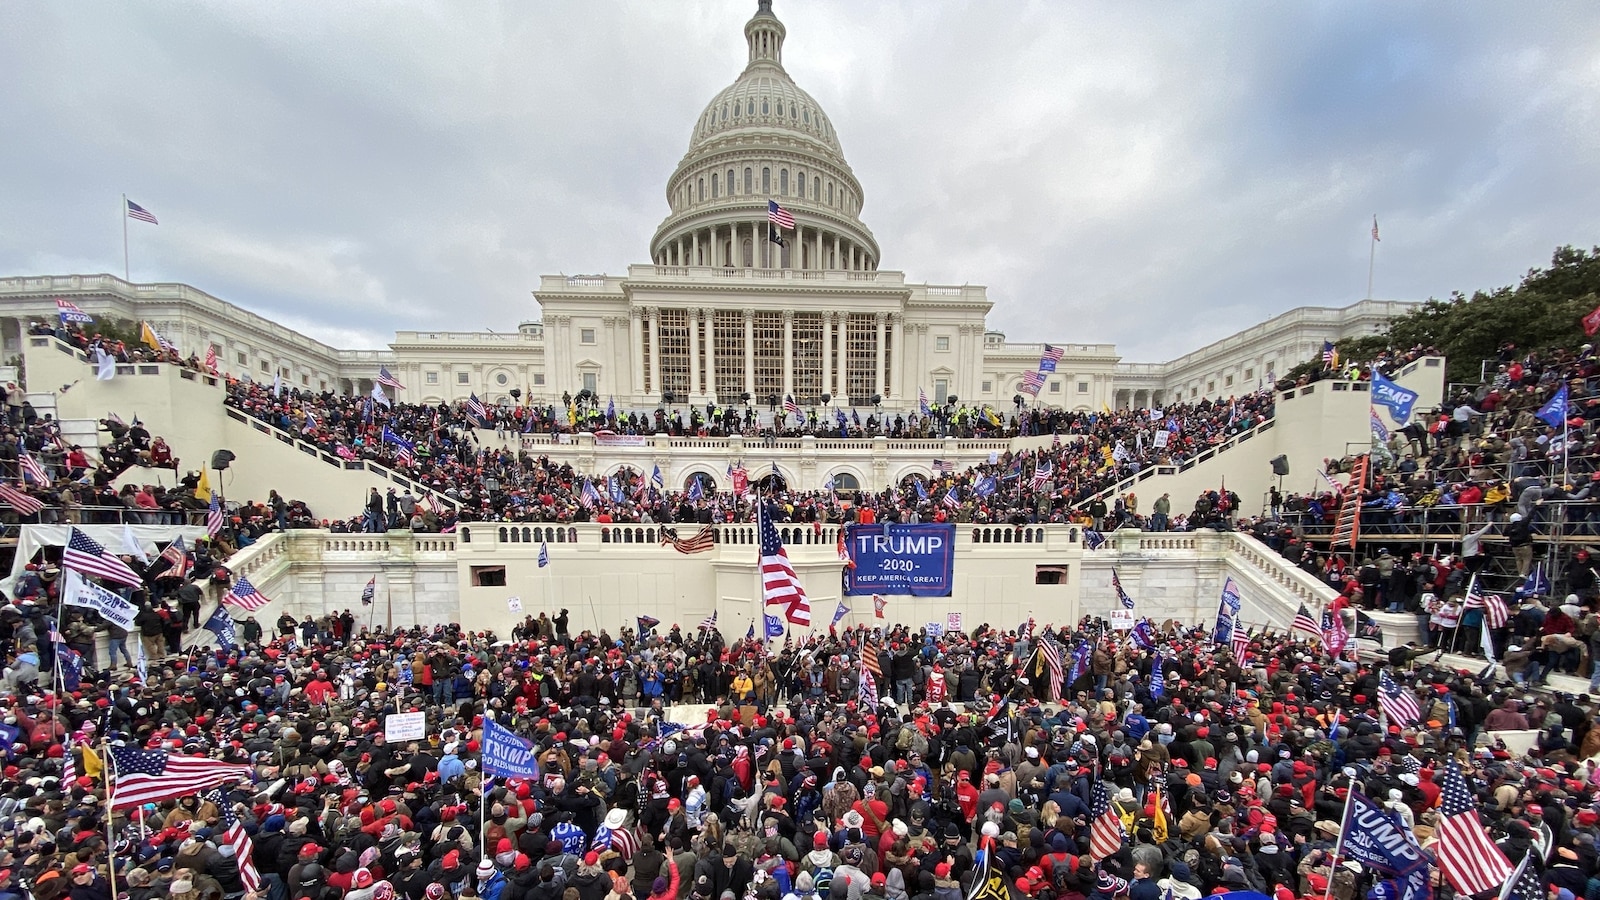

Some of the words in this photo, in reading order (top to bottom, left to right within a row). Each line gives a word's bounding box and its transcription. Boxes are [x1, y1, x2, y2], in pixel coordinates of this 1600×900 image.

[66, 313, 93, 322] 2020
[857, 535, 942, 555] TRUMP
[879, 574, 912, 582] AMERICA
[78, 596, 88, 604] NO
[100, 606, 130, 625] BULLSHIT
[485, 738, 532, 766] TRUMP
[493, 758, 508, 770] BLESS
[1353, 798, 1419, 861] RUMP
